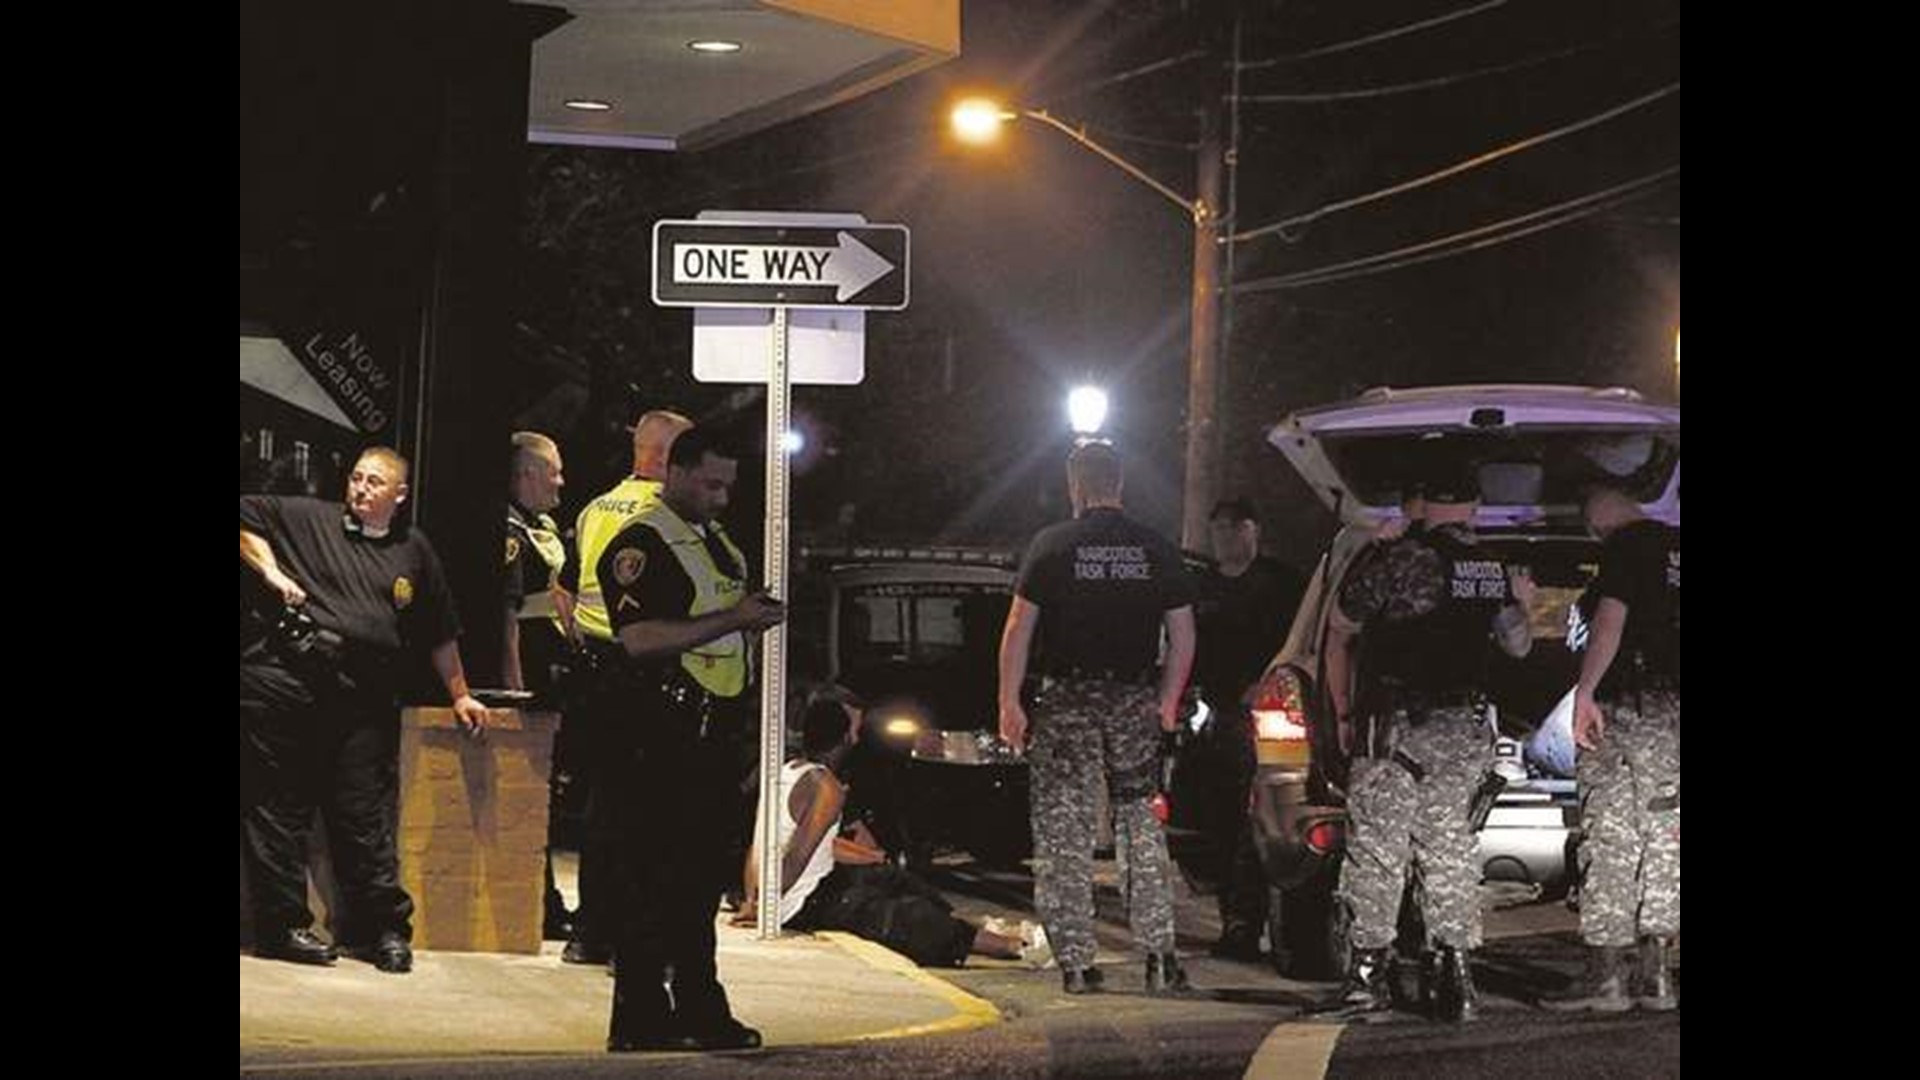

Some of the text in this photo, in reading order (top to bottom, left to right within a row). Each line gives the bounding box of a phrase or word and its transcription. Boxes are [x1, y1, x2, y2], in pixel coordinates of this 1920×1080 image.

[683, 248, 833, 281] ONE WAY
[339, 331, 391, 390] Now
[305, 333, 388, 433] Leasing
[595, 498, 639, 515] OLICE
[1076, 546, 1147, 562] NARCOTICS
[1074, 562, 1153, 580] TASK FORCE
[1451, 579, 1507, 598] TASK FORCE
